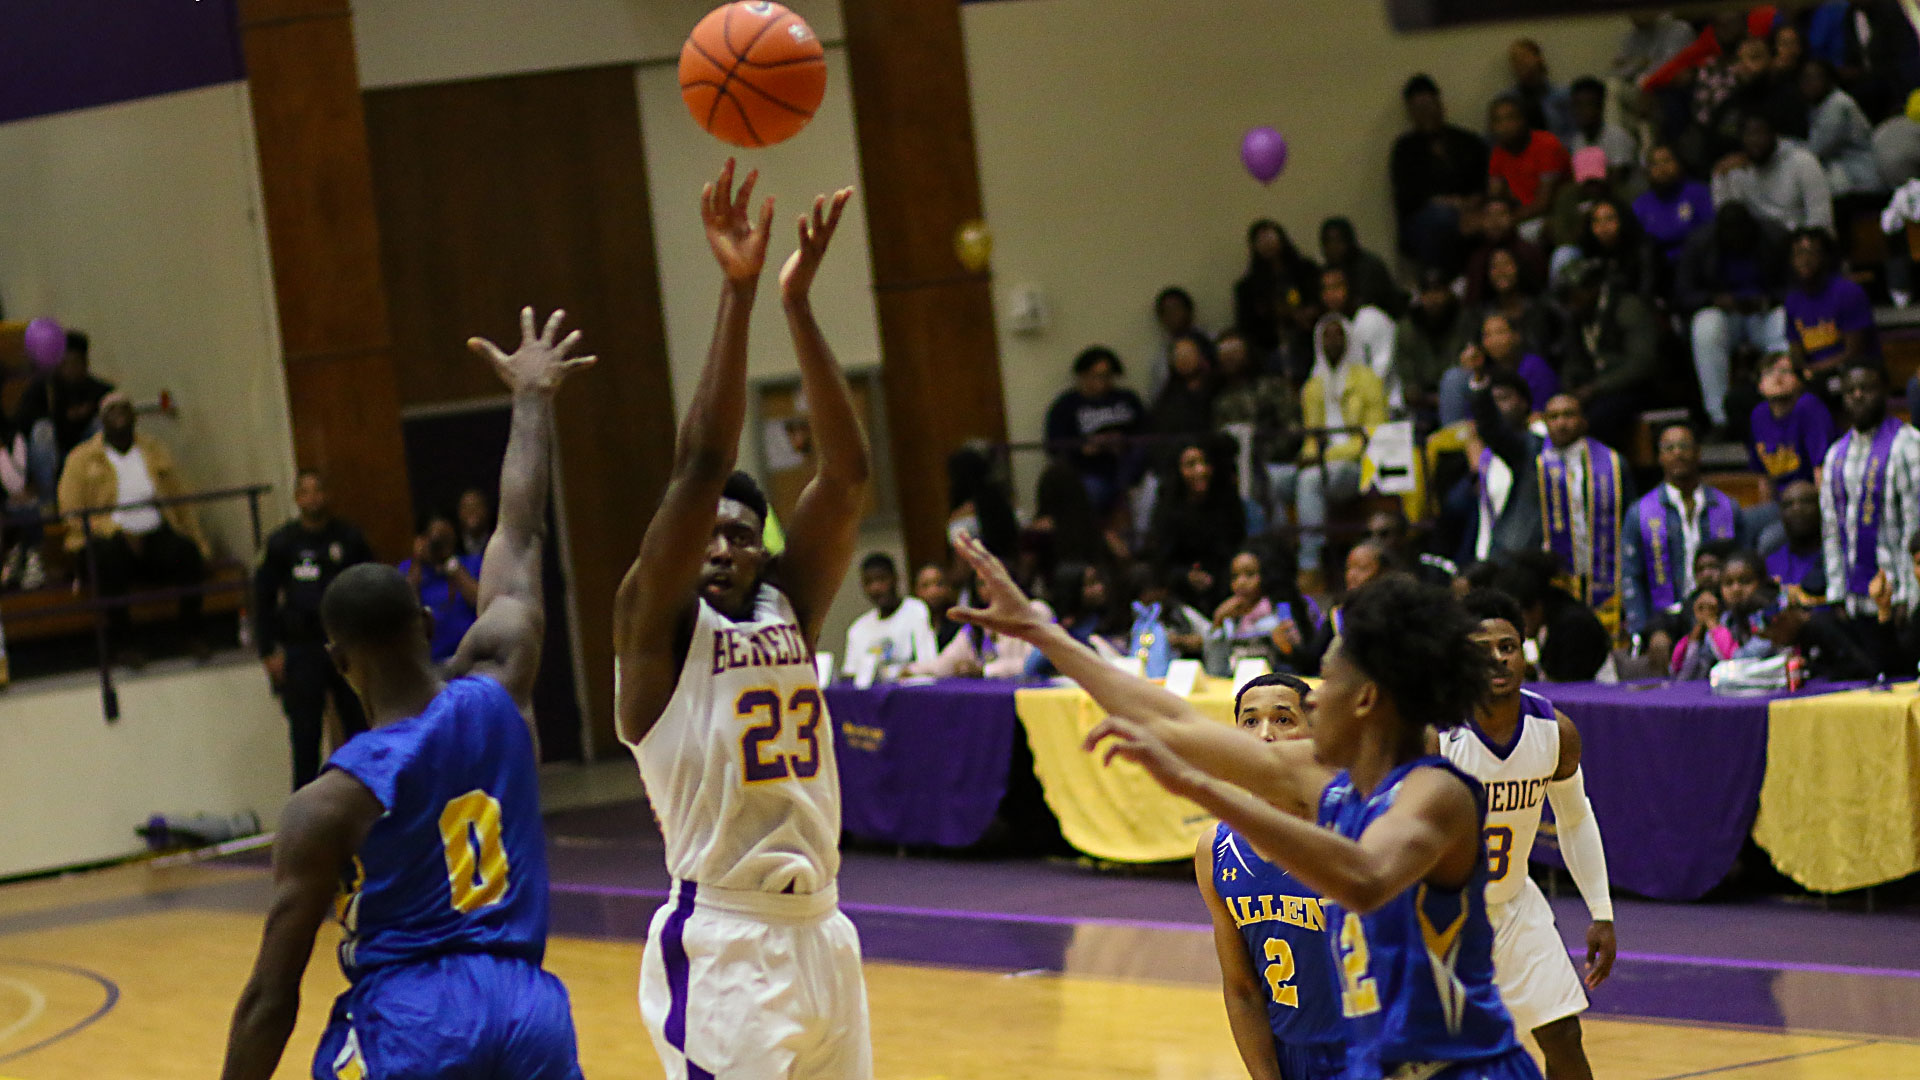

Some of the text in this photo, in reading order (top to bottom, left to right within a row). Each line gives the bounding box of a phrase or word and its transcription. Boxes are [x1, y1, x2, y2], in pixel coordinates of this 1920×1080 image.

[736, 685, 821, 785] 23
[438, 788, 509, 914] 0
[1263, 937, 1299, 1008] 2
